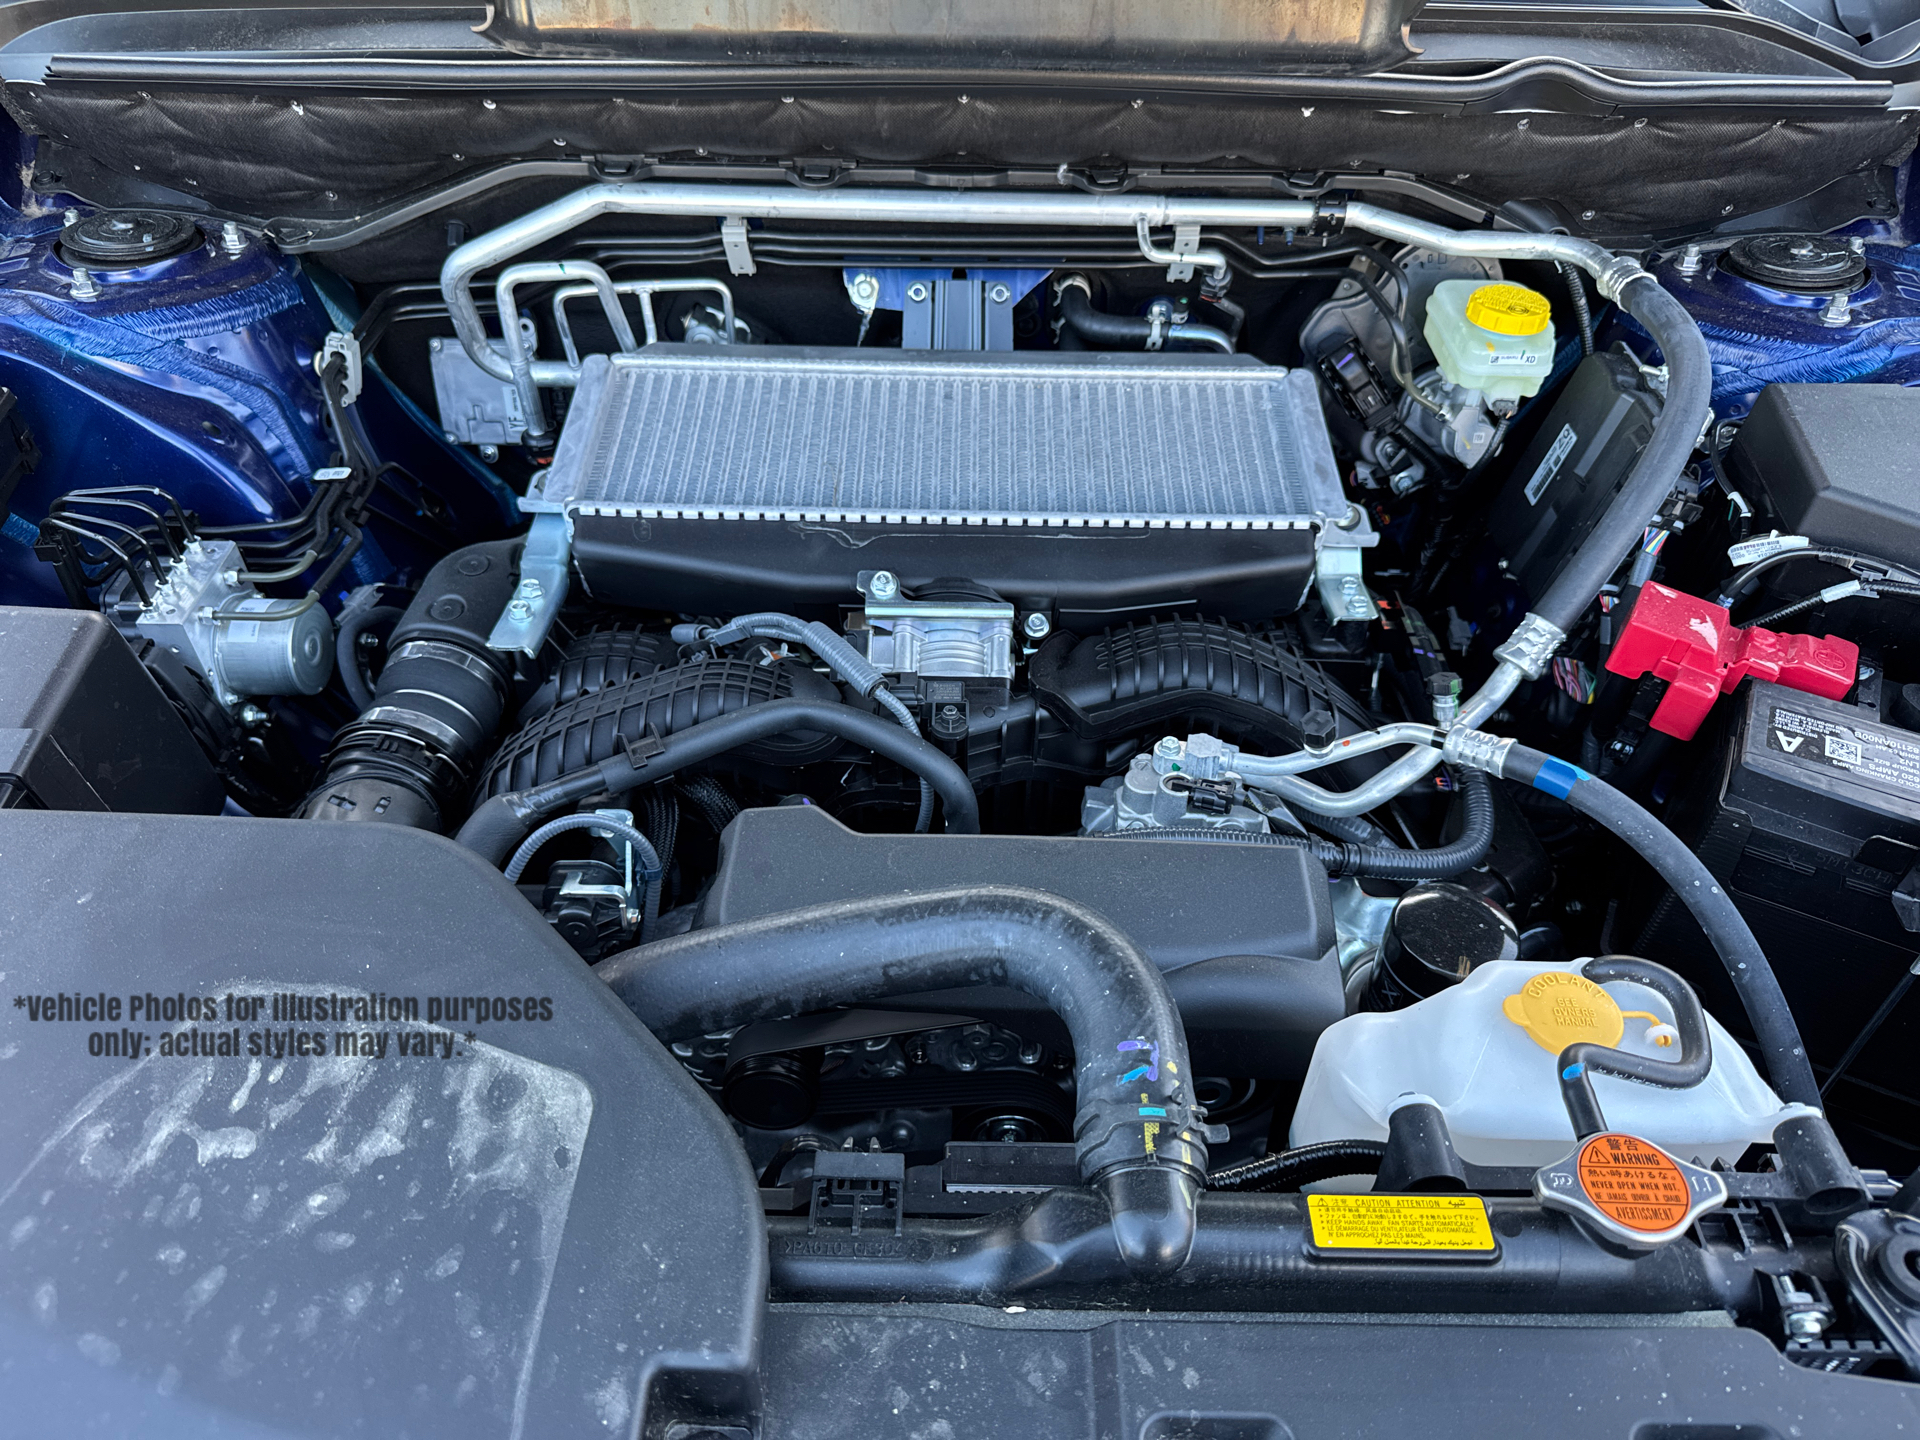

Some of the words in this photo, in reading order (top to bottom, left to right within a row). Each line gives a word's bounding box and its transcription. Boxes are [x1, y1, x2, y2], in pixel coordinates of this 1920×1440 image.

[1524, 355, 1536, 363] XD
[1832, 760, 1853, 768] AMPS
[1873, 758, 1890, 766] SIZE
[1899, 758, 1920, 768] LN2
[1855, 766, 1897, 782] CRANKING
[1868, 763, 1899, 776] AMPS
[1892, 764, 1920, 774] GROUP
[1901, 773, 1920, 782] 620
[1528, 974, 1607, 998] COOLANT
[1557, 998, 1578, 1006] SEE
[1556, 1017, 1599, 1027] MANUAL
[1606, 1138, 1638, 1151] 警告
[1610, 1152, 1660, 1165] WARNING
[1590, 1181, 1613, 1189] NEVER
[1355, 1199, 1390, 1207] CAUTION
[1397, 1200, 1440, 1208] ATTENTION
[1616, 1206, 1675, 1221] AVERTISSMENT
